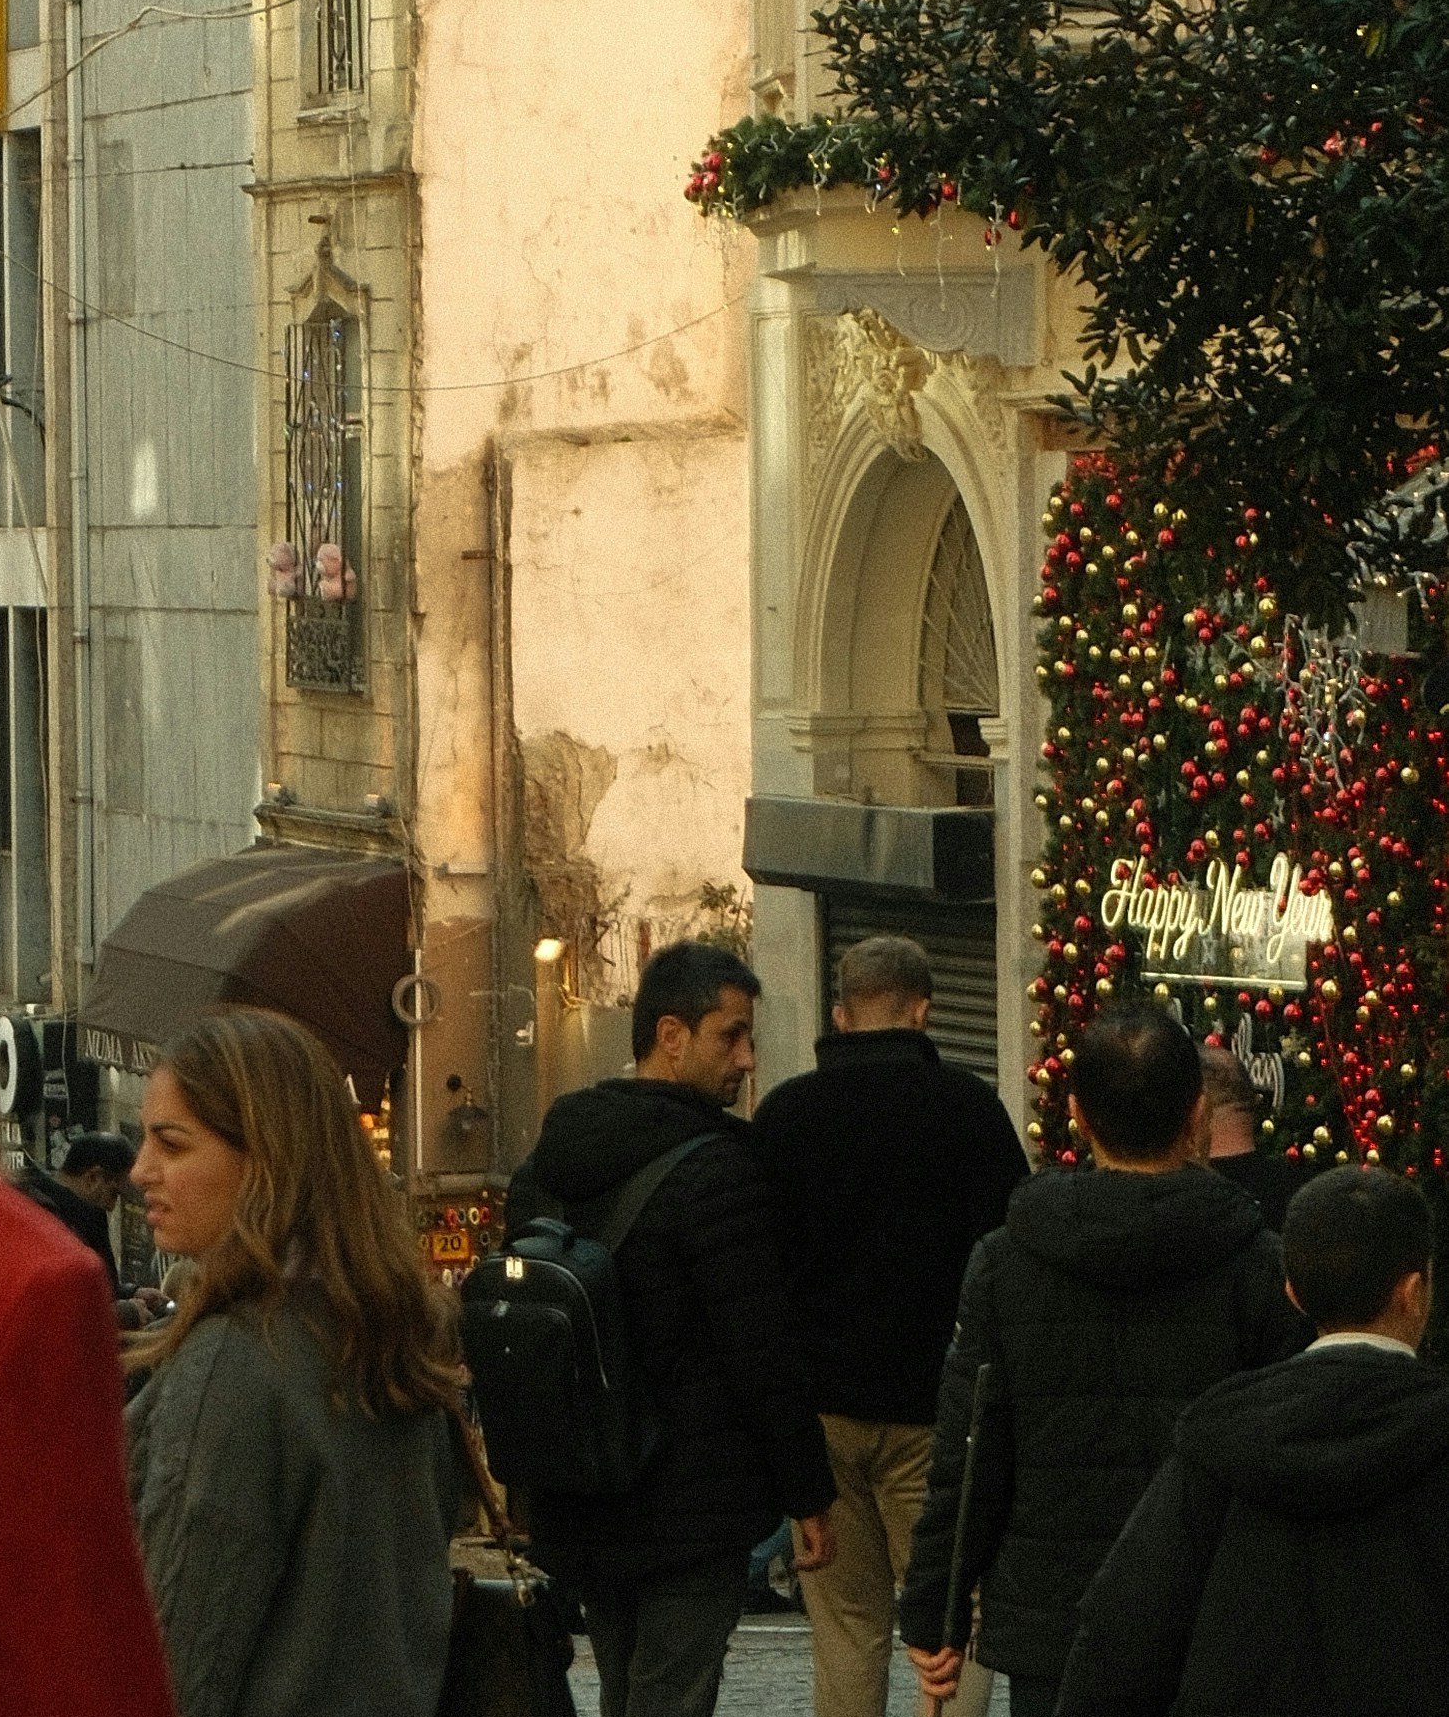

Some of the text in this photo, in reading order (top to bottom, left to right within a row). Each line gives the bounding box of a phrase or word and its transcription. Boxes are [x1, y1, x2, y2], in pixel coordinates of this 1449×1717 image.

[1101, 851, 1335, 964] Happy New Year
[440, 1235, 462, 1252] 20
